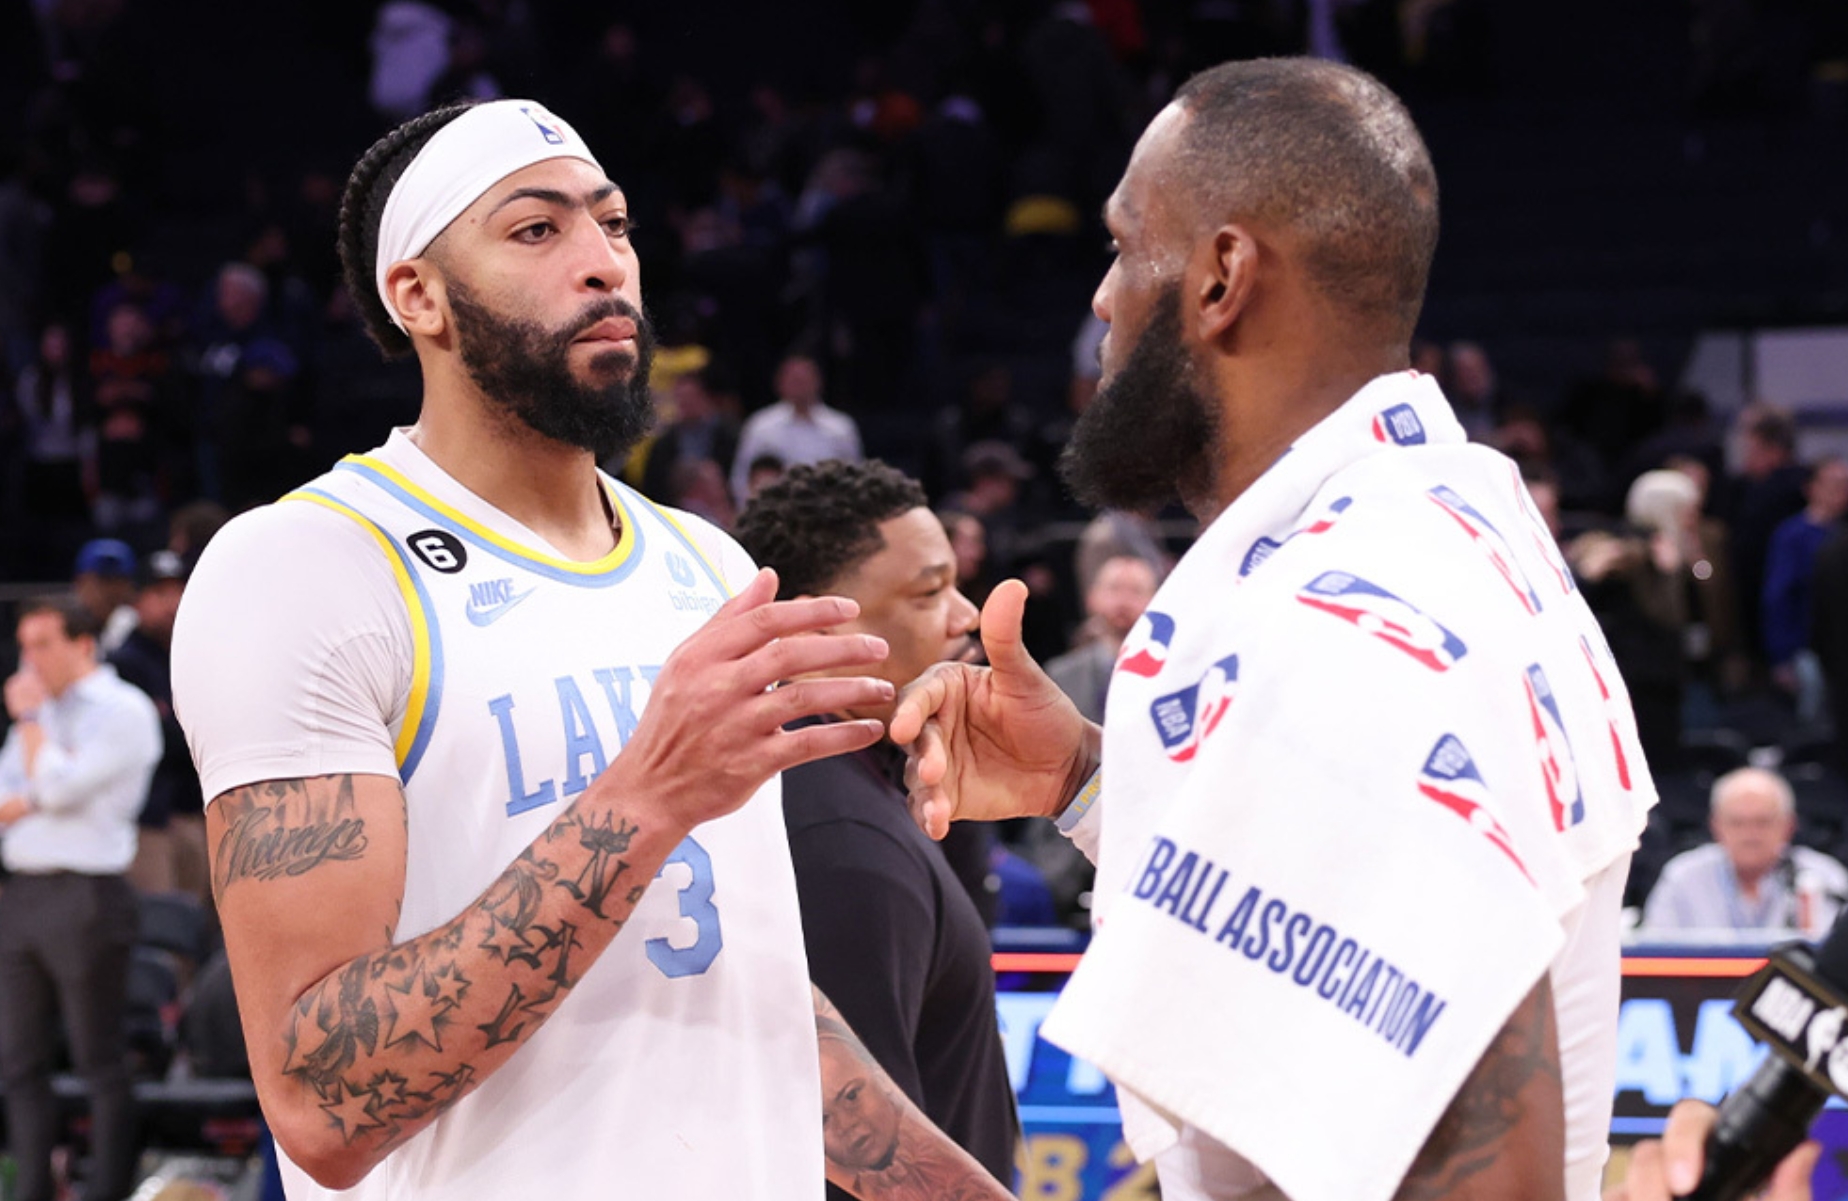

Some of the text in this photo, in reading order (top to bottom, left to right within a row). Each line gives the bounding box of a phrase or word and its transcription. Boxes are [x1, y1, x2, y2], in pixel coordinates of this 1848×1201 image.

[415, 536, 459, 570] 6
[469, 578, 518, 607] NIKE
[488, 665, 662, 817] LAK
[1154, 698, 1191, 740] NBA
[645, 835, 723, 978] 3
[1126, 836, 1230, 934] BALL
[1215, 886, 1448, 1058] ASSOCIATION
